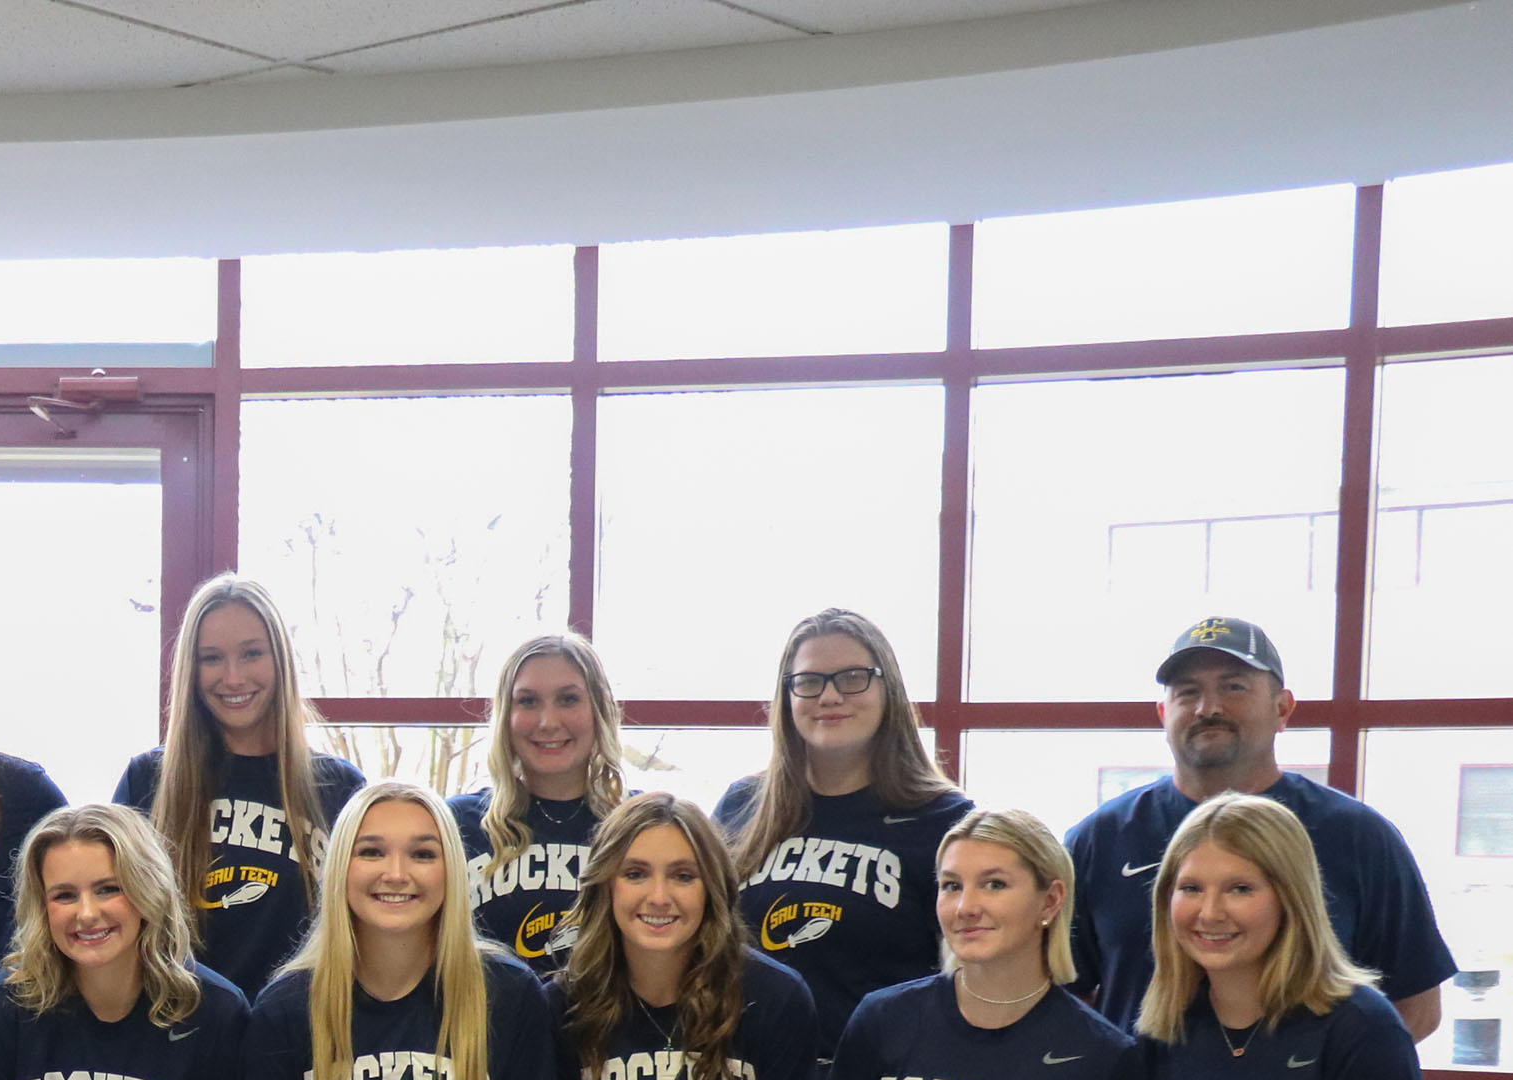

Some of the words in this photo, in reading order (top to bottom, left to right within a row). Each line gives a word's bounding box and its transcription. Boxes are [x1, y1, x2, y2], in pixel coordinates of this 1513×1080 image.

[239, 865, 279, 887] TECH
[738, 837, 902, 910] OCKETS
[525, 912, 555, 939] SAU
[769, 904, 799, 930] SAU
[803, 902, 843, 921] TECH
